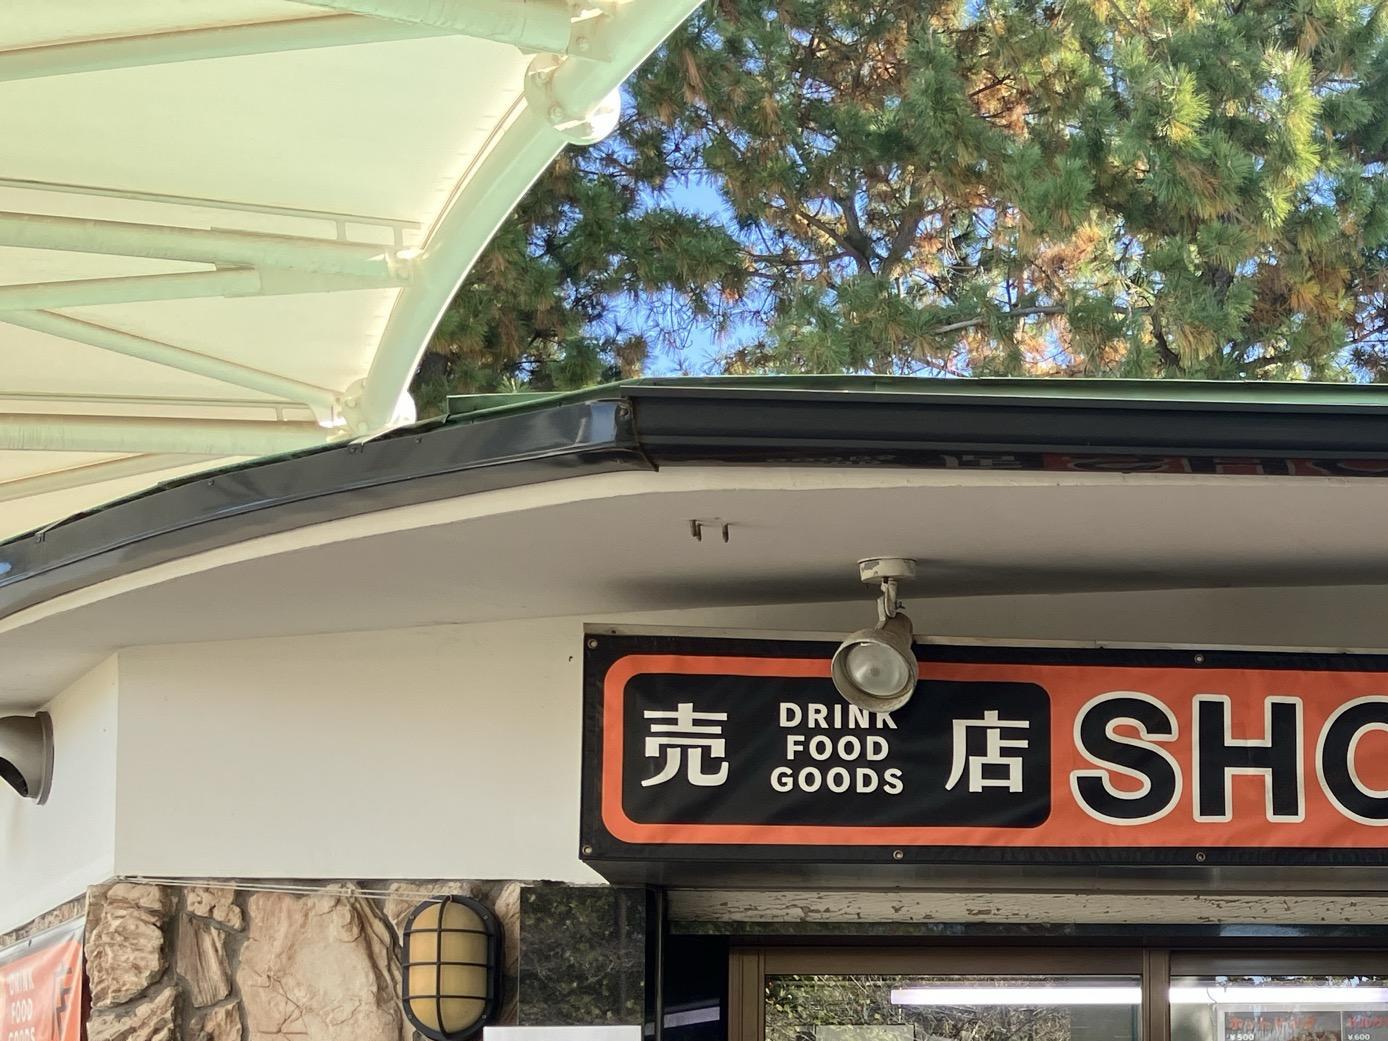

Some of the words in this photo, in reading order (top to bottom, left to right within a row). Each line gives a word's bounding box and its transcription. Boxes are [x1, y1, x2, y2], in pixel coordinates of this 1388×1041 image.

[779, 702, 899, 731] DRINK
[641, 702, 729, 788] 売
[785, 735, 890, 763] FOOD
[945, 710, 1030, 793] 店
[770, 767, 904, 796] GOODS
[1347, 1033, 1370, 1041] ¥600
